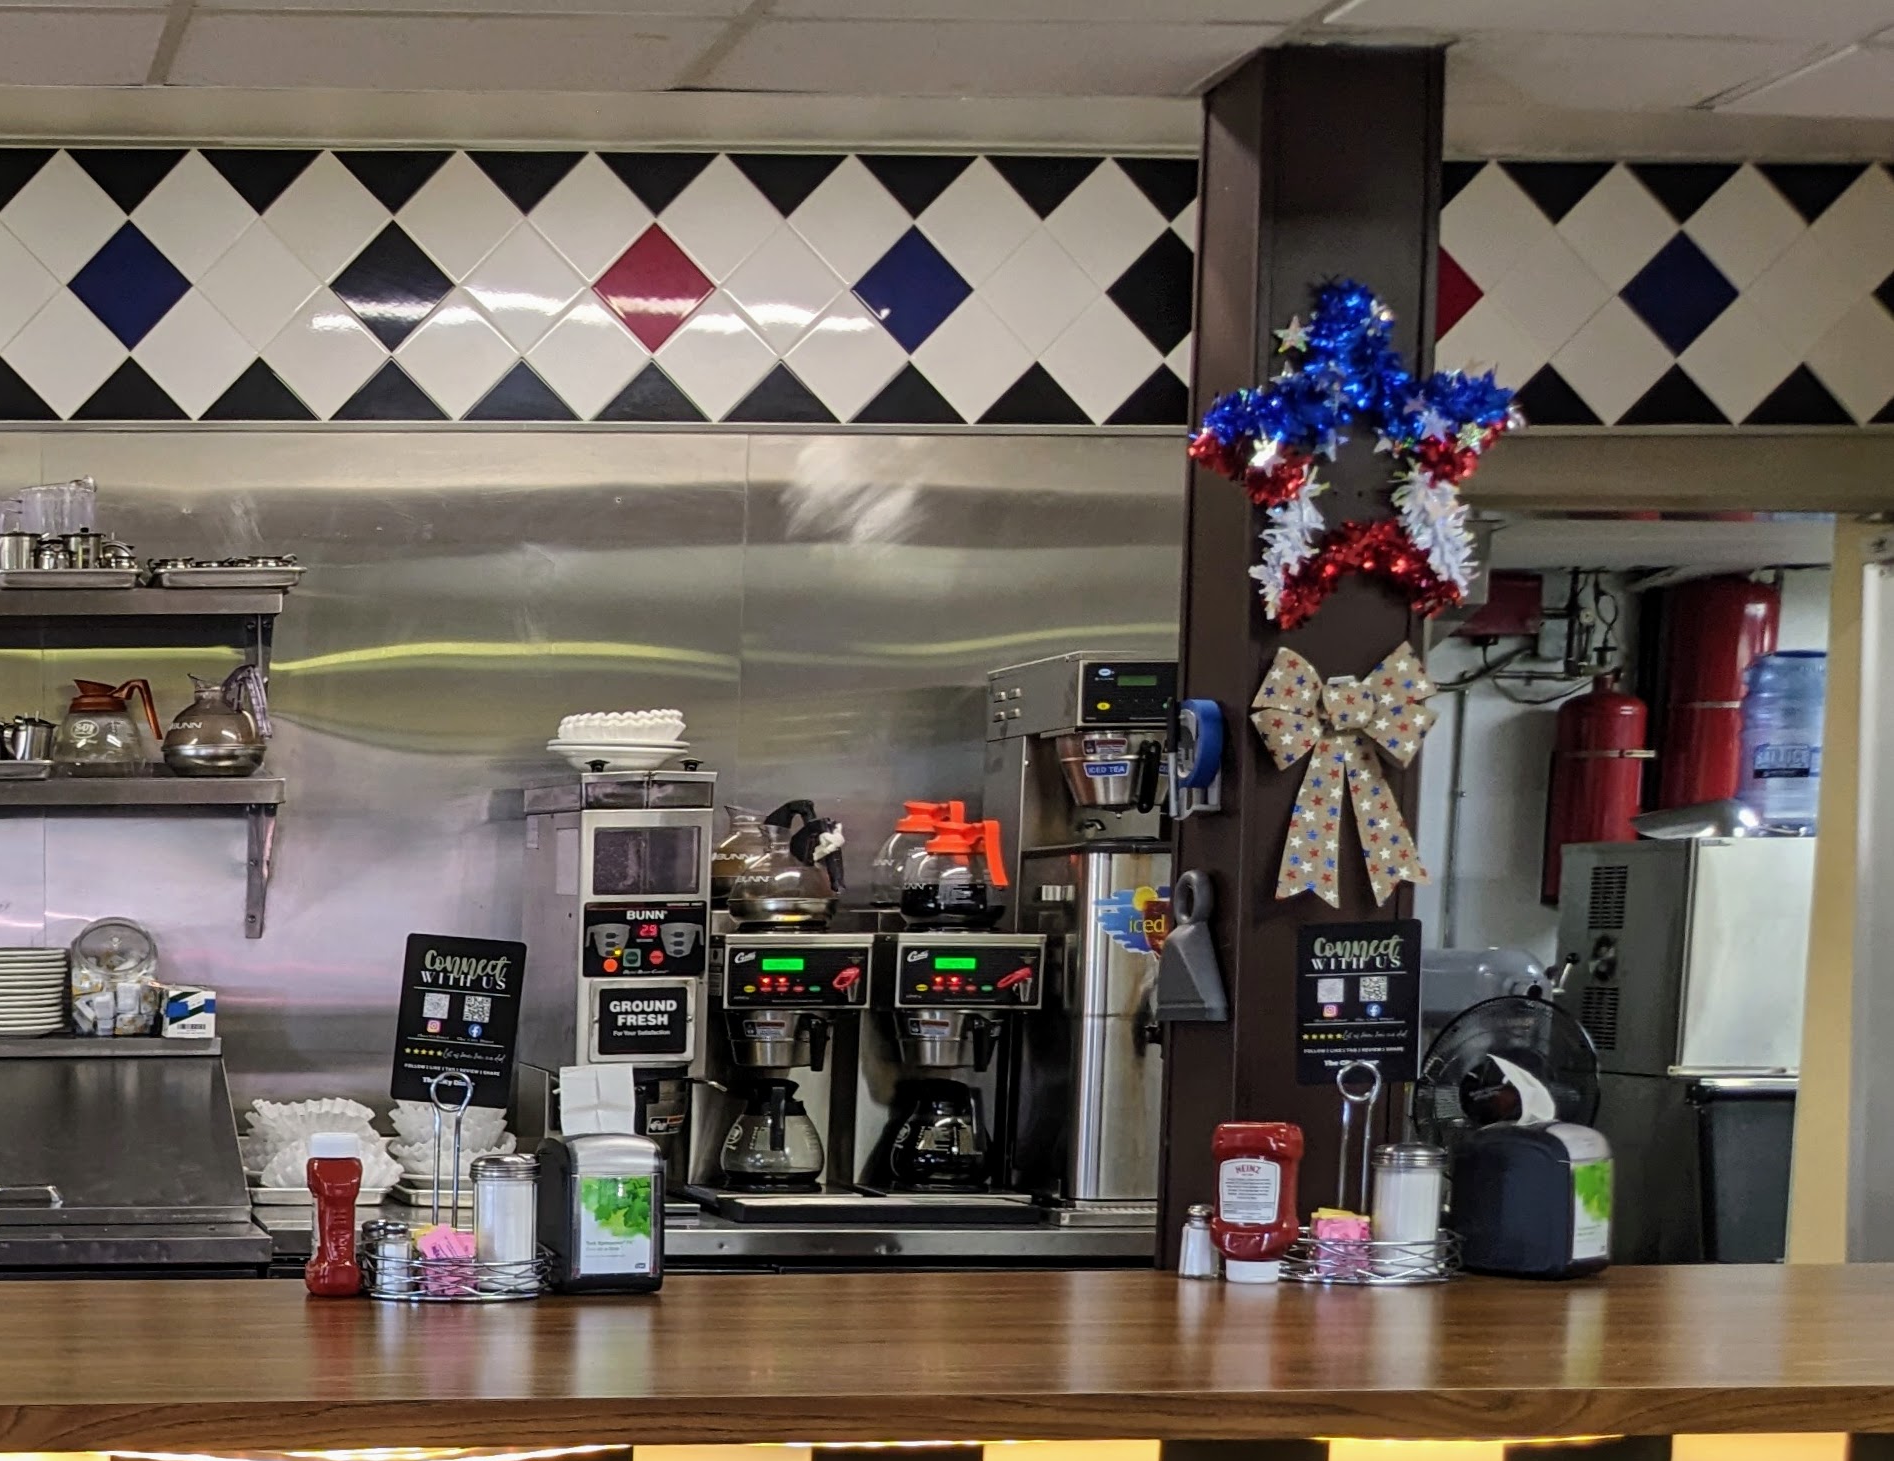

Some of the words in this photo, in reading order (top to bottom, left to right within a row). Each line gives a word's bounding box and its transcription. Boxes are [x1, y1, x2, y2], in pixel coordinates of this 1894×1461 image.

[1088, 766, 1106, 774] ICED
[1109, 765, 1126, 773] TEA
[625, 909, 665, 921] BUNN
[1129, 913, 1165, 933] iced
[639, 924, 658, 937] 29
[1313, 934, 1405, 962] Connect
[424, 949, 512, 980] Connect
[1310, 957, 1365, 970] WITH
[1375, 955, 1402, 968] US
[420, 970, 472, 987] WITH
[481, 976, 507, 990] US
[609, 999, 678, 1013] GROUND
[616, 1013, 669, 1027] FRESH
[1235, 1164, 1262, 1174] HEINZ
